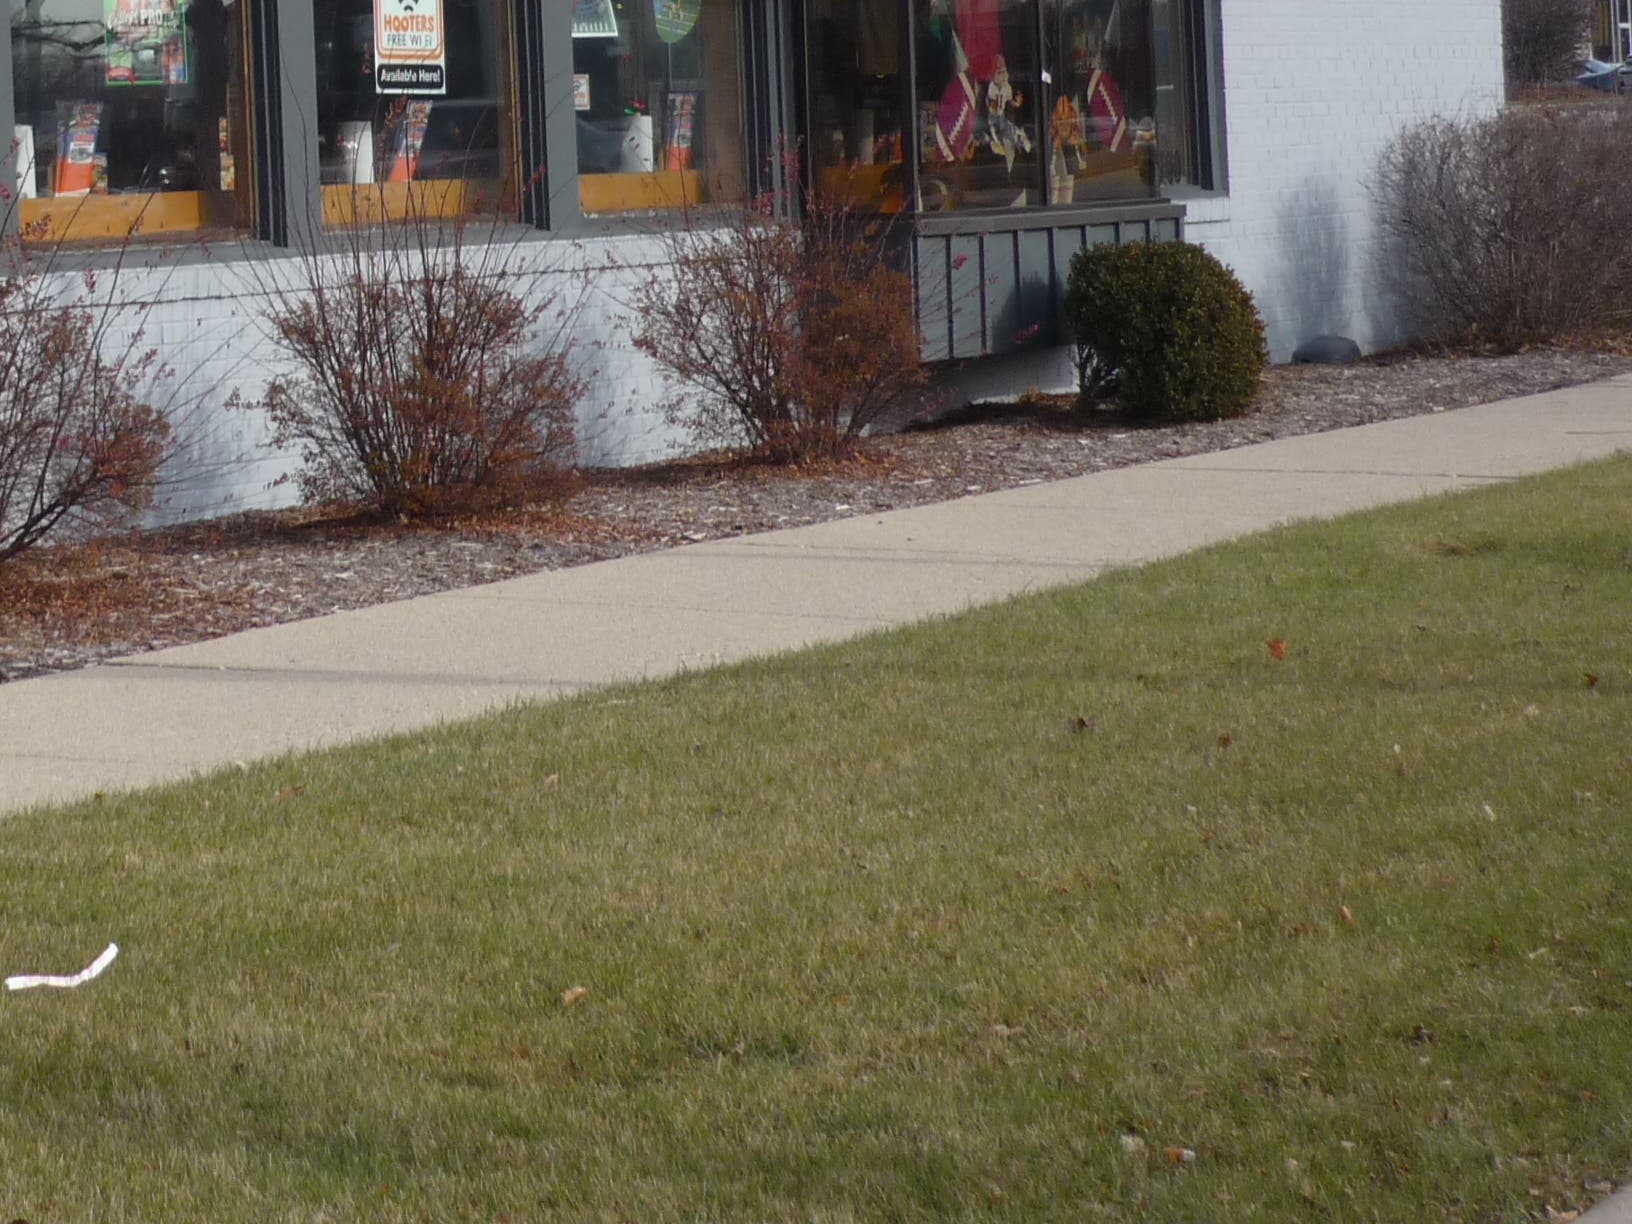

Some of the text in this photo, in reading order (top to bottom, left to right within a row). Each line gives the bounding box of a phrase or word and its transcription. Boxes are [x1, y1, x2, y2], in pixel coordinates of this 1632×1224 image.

[384, 14, 434, 33] HOOTERS
[387, 34, 407, 47] FREE
[409, 34, 422, 47] WI
[380, 68, 441, 83] Available Here!
